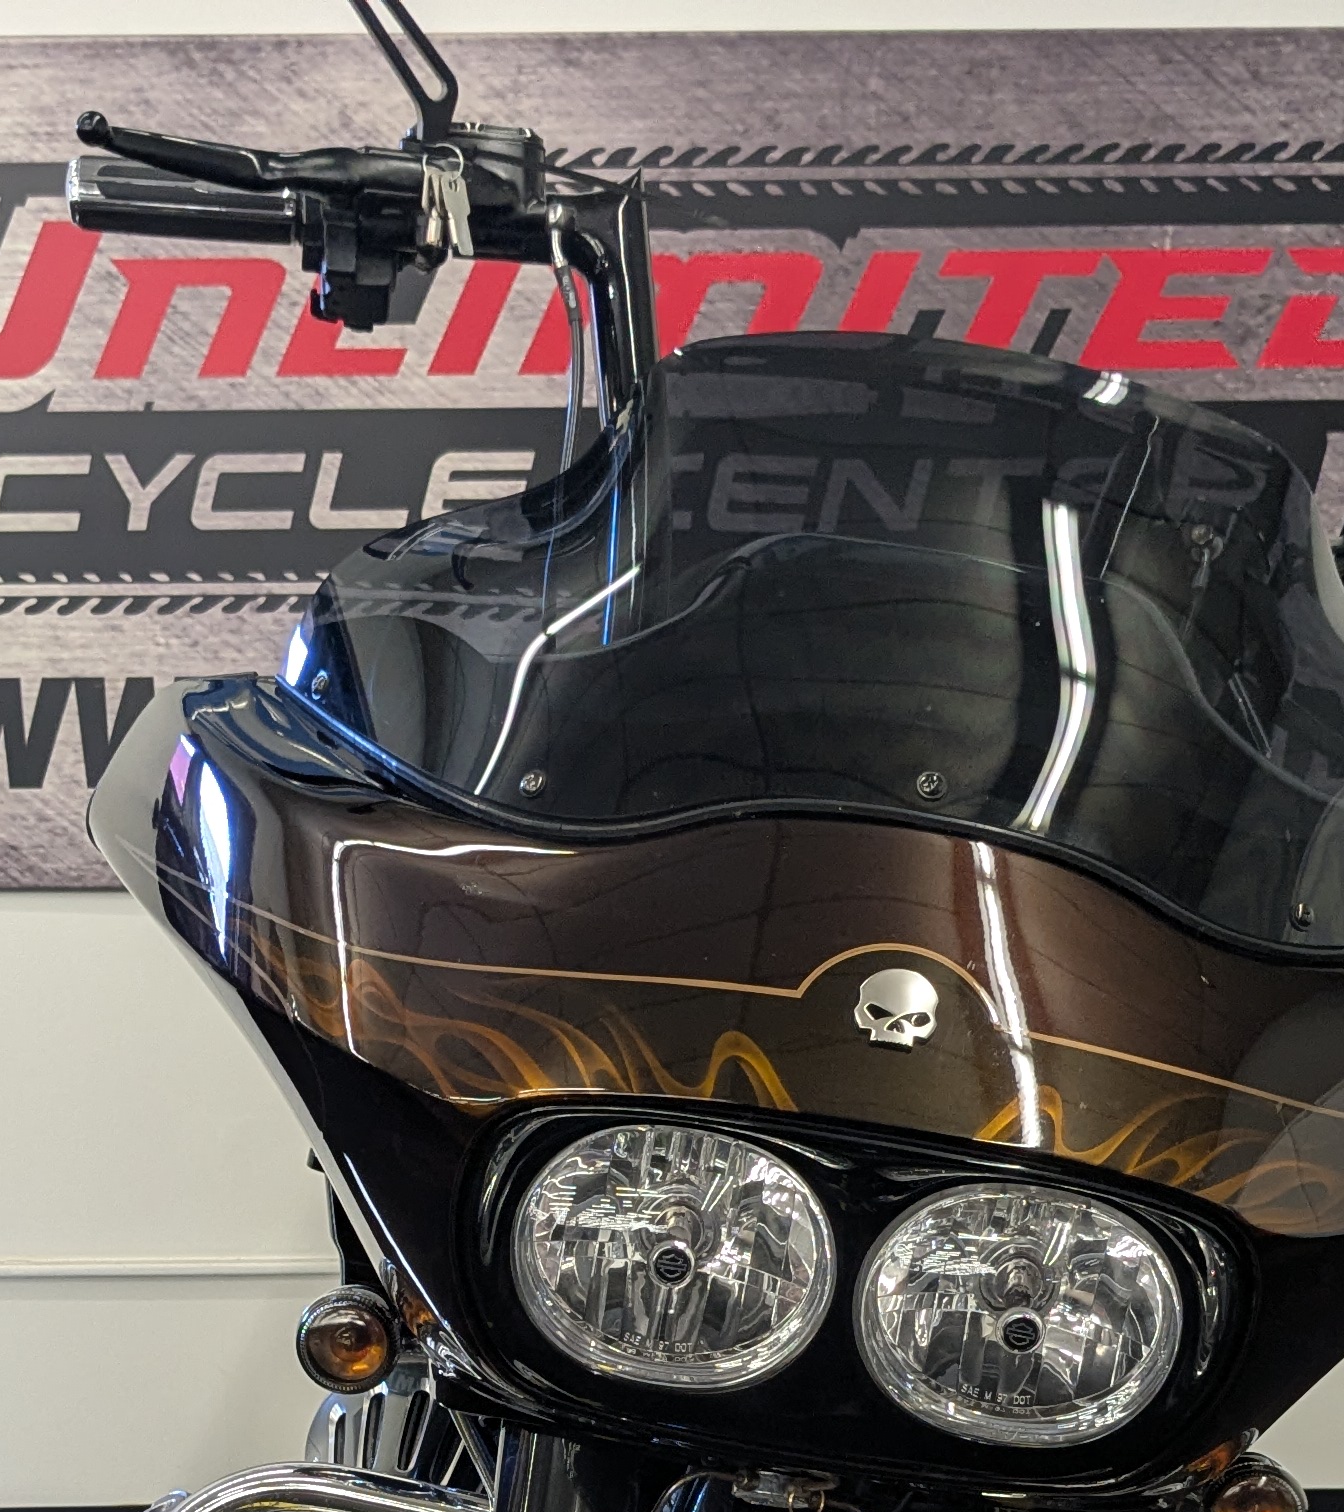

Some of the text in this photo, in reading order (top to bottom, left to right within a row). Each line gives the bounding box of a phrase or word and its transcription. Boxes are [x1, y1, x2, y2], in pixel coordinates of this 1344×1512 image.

[668, 436, 1268, 534] ENTER
[674, 1342, 693, 1353] DOT
[961, 1383, 1032, 1405] SAE M 97 DOT
